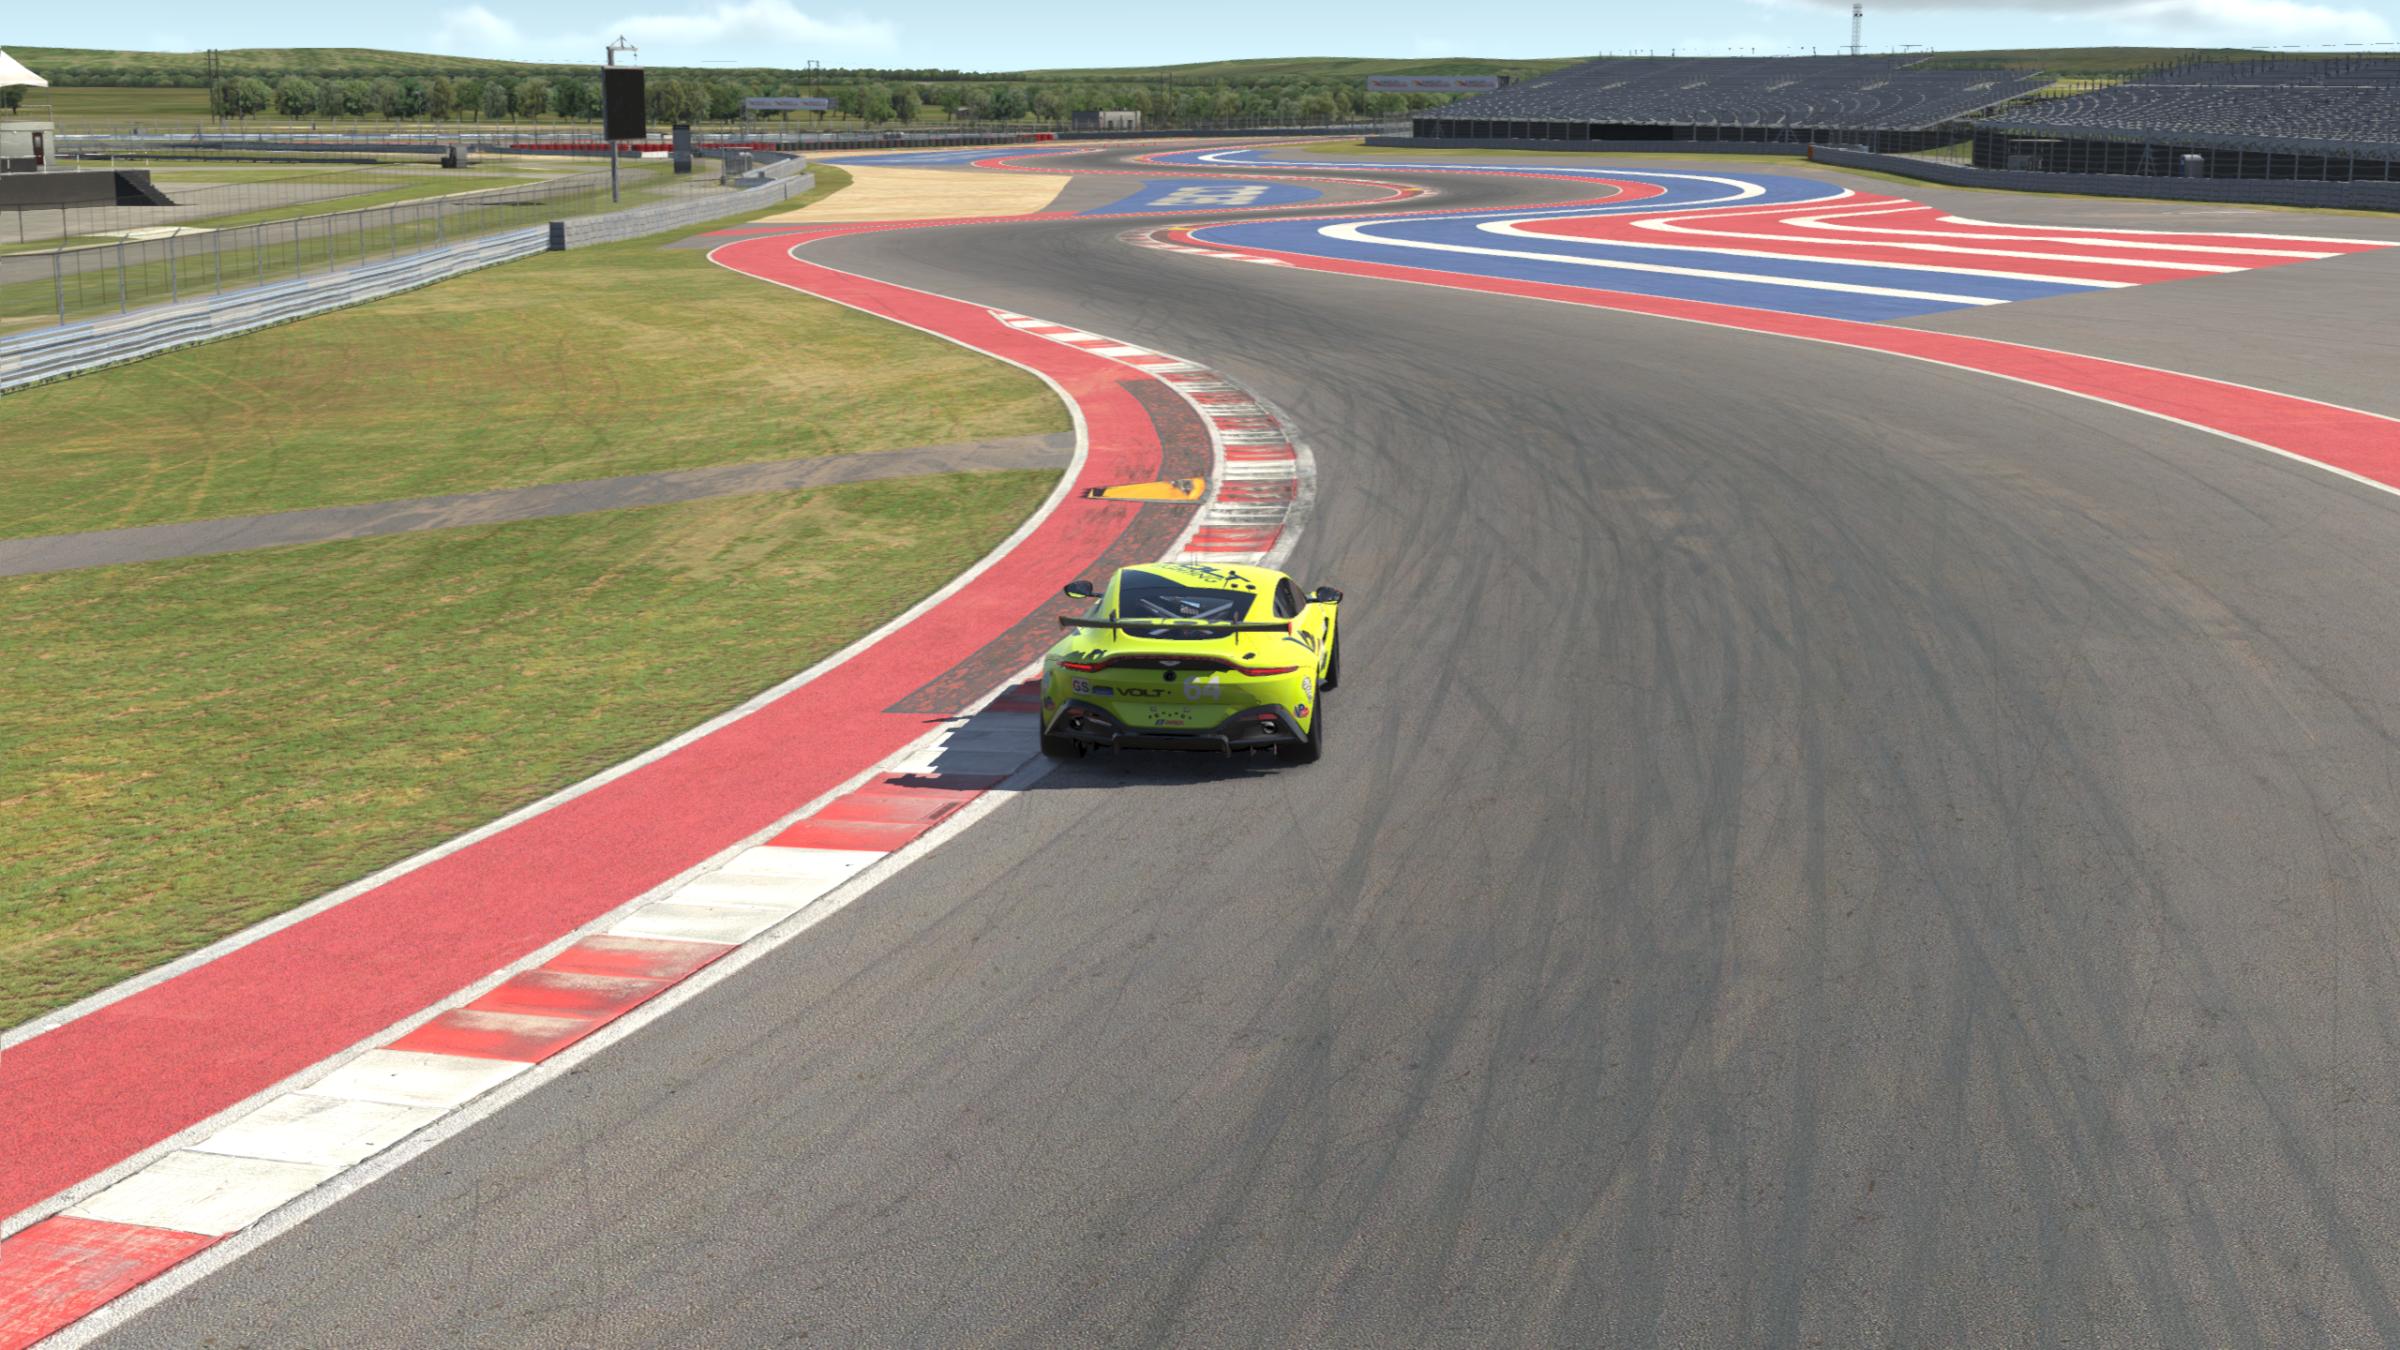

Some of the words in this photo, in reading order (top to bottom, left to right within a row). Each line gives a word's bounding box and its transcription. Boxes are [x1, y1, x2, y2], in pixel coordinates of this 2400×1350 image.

[1072, 680, 1089, 692] GS
[1117, 687, 1165, 697] VOLT
[1184, 675, 1220, 701] 64
